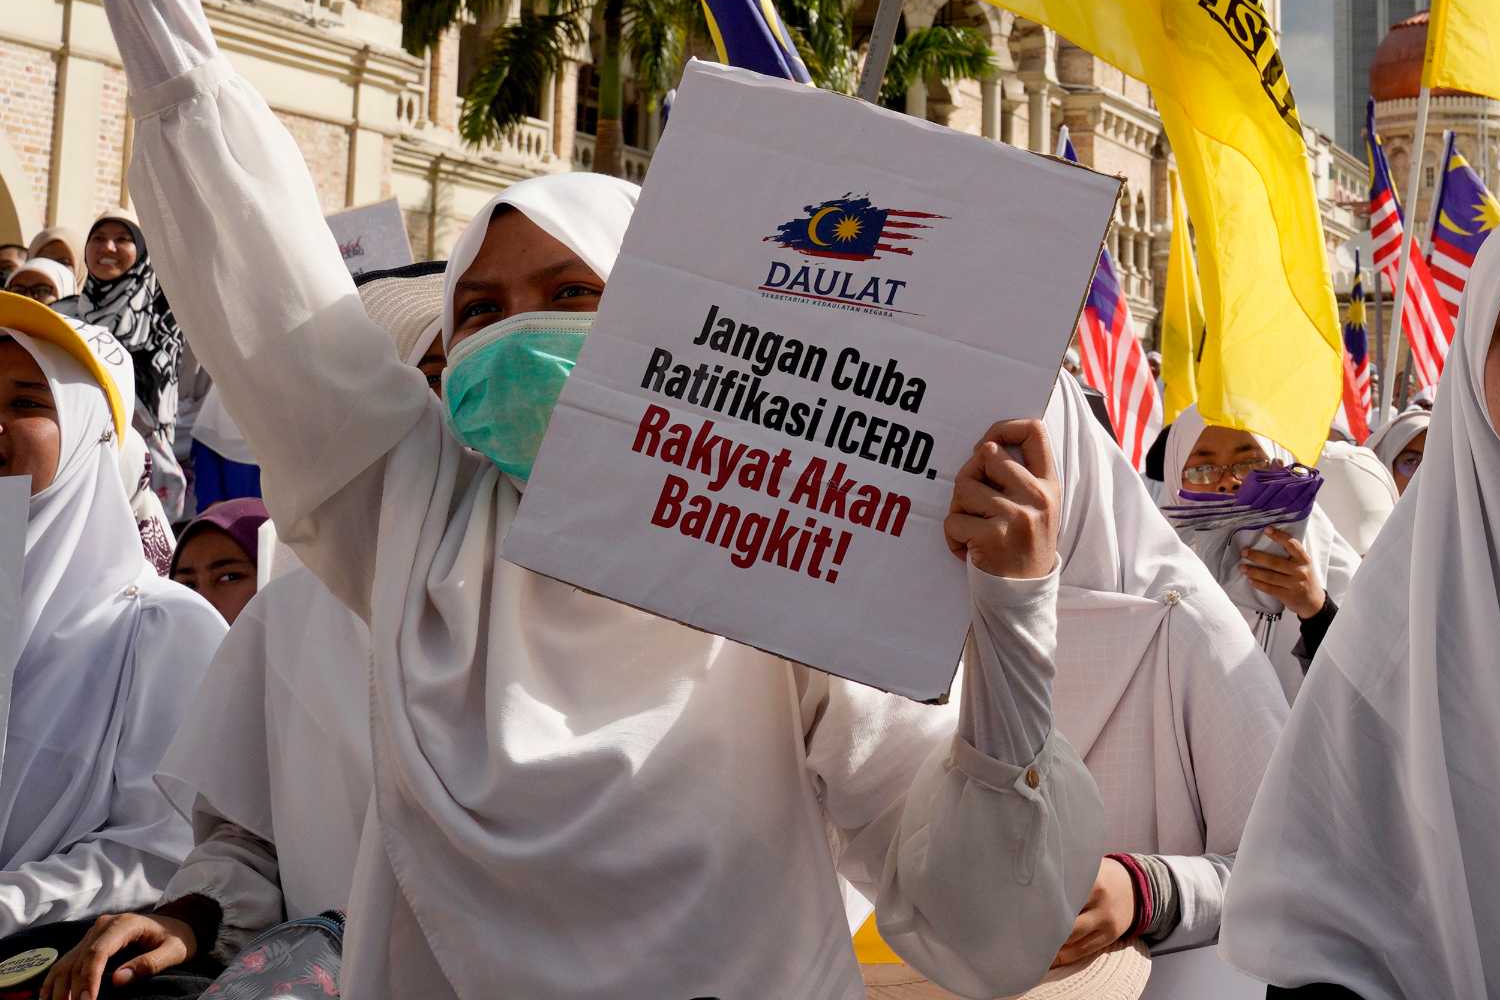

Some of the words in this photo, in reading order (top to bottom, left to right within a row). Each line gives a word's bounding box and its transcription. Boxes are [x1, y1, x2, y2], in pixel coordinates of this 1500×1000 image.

[760, 292, 809, 304] SEKRETARIAT
[812, 300, 861, 313] KEDAULATAN
[863, 308, 893, 318] NEGARA
[764, 261, 907, 305] DAULAT
[641, 347, 828, 442] Ratifikasi
[824, 405, 938, 480] ICERD.
[693, 304, 828, 382] Jangan
[831, 347, 927, 414] Cuba
[631, 403, 793, 498] Rakyat
[788, 456, 912, 538] Akan
[651, 474, 853, 585] Bangkit!
